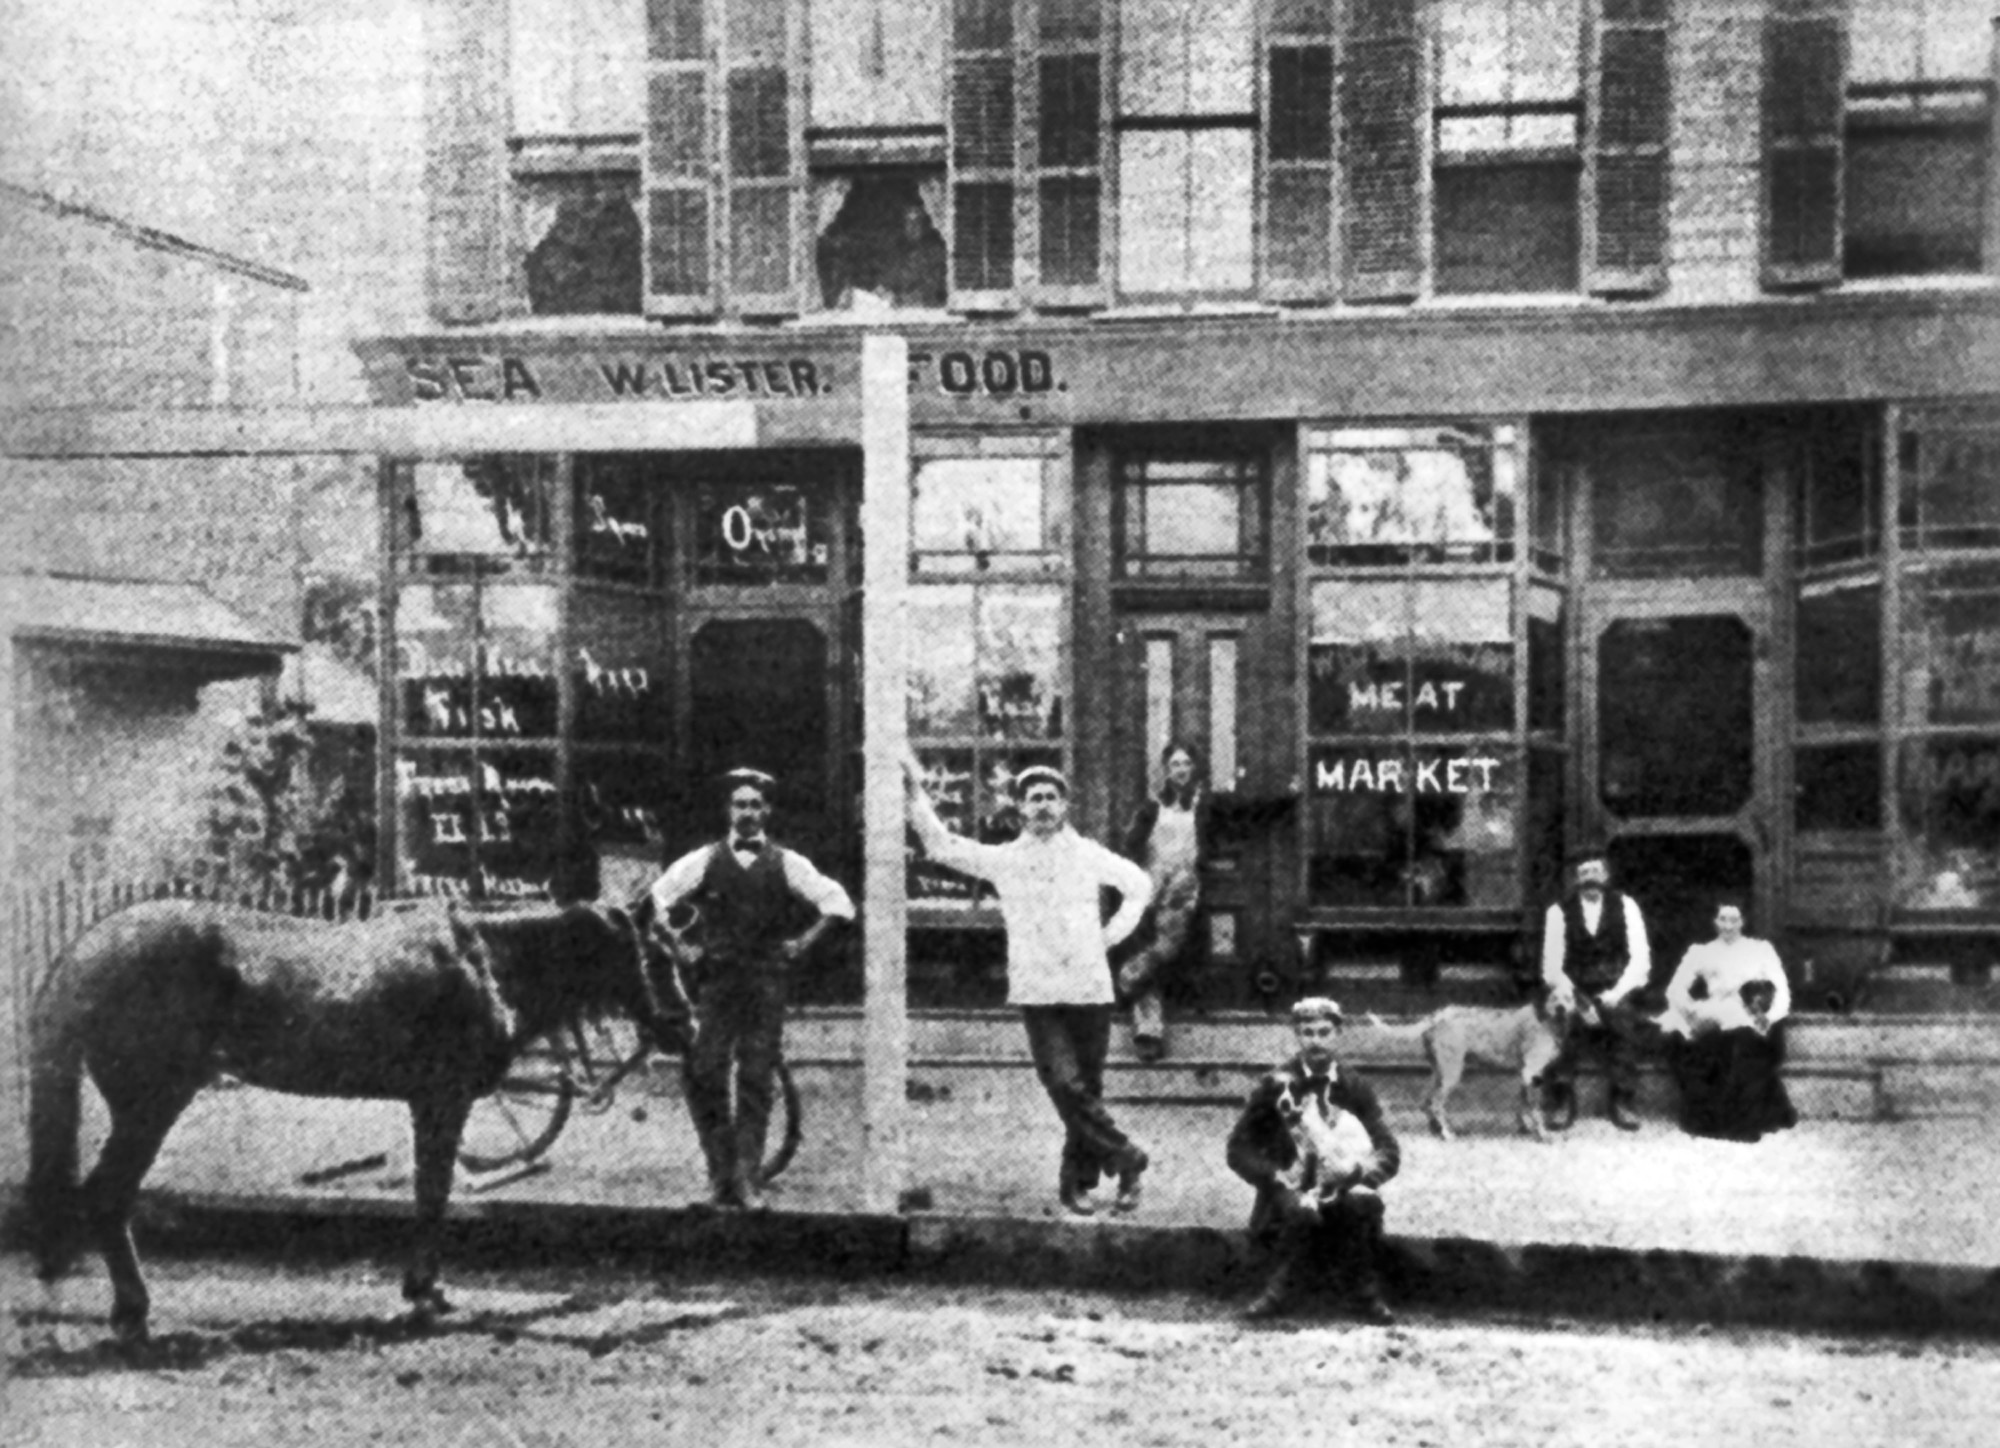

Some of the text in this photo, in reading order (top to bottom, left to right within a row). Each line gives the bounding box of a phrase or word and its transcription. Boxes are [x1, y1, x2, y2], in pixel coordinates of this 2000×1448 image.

[406, 356, 541, 400] SEA
[1348, 680, 1465, 710] MEAT
[1316, 757, 1501, 793] MARKET
